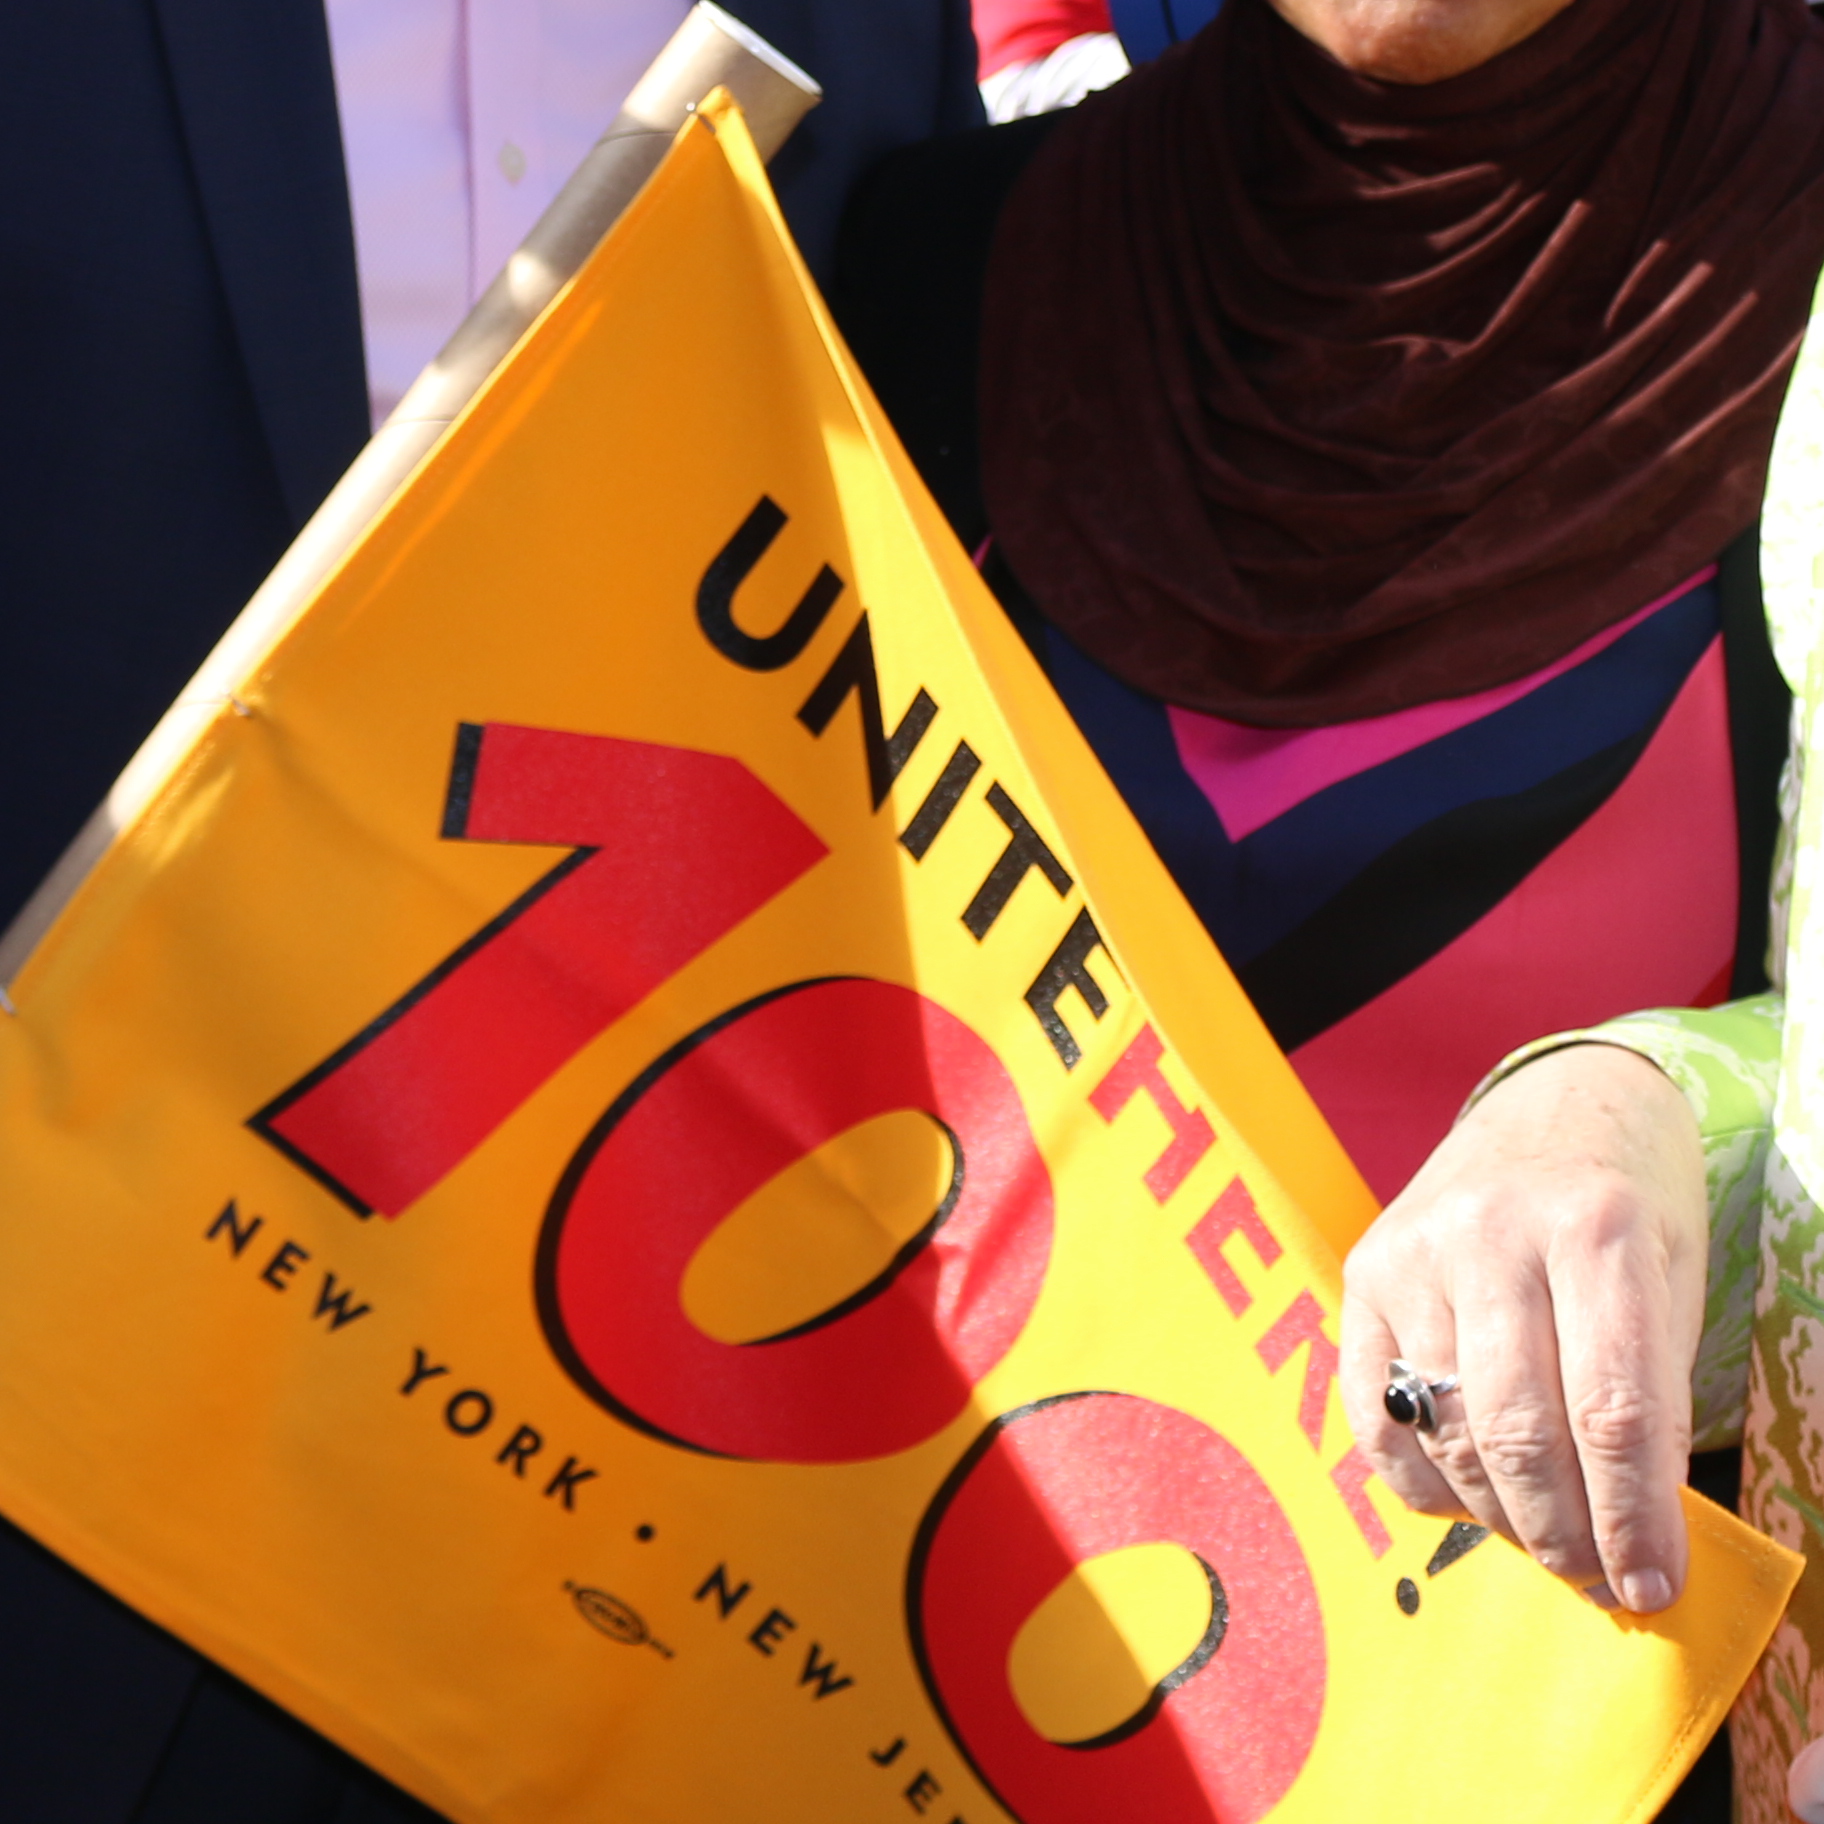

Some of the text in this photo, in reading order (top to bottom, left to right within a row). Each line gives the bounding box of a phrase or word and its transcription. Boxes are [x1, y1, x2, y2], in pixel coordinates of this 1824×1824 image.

[204, 1196, 372, 1333] NEW
[398, 1345, 598, 1512] YORK
[692, 1561, 854, 1701] NEW
[868, 1736, 971, 1824] JE
[242, 721, 1329, 1824] 100
